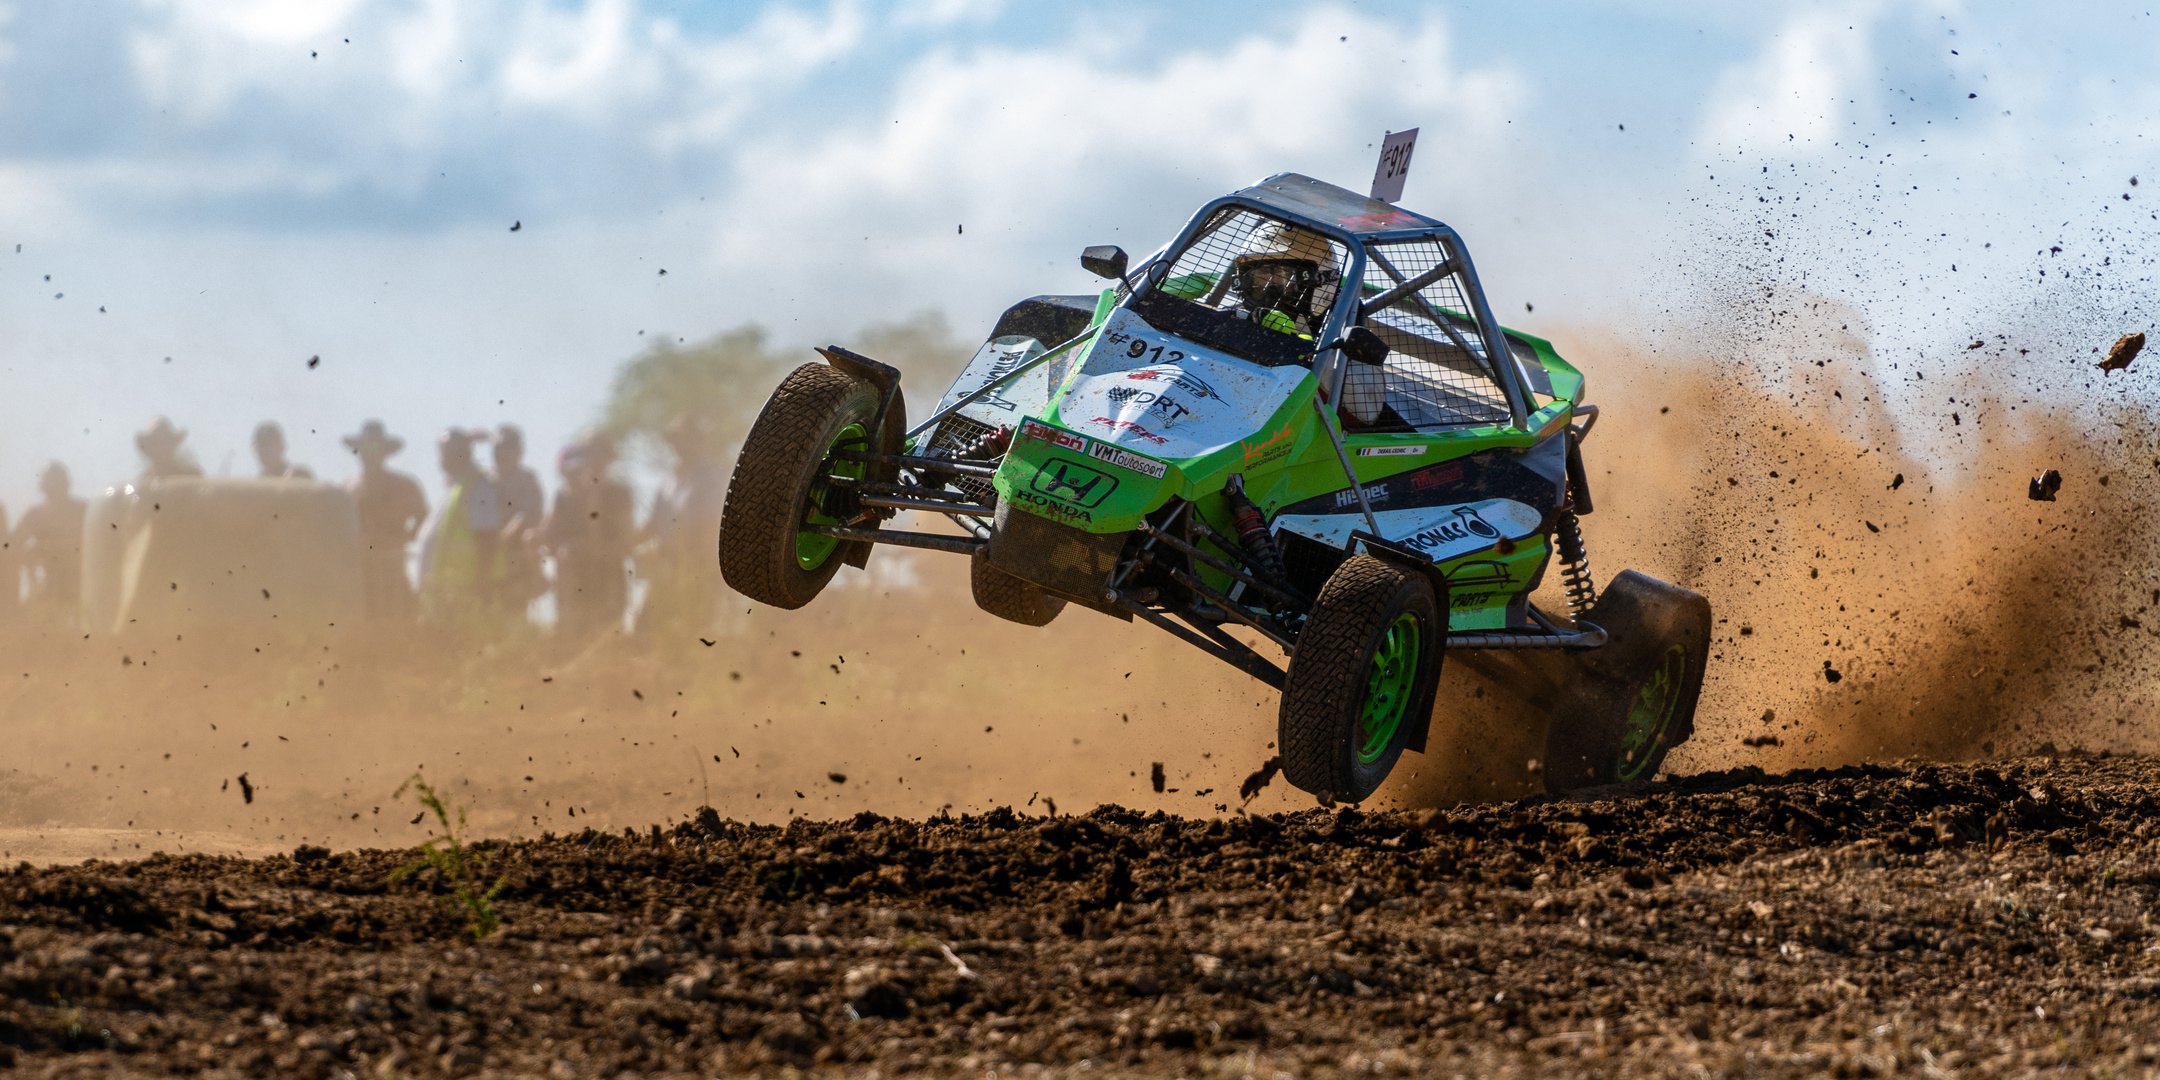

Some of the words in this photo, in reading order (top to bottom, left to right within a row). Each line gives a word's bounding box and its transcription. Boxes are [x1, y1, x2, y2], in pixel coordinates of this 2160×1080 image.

[1381, 141, 1412, 178] #912
[1108, 332, 1184, 365] #912
[1134, 391, 1189, 419] DRT
[1094, 444, 1164, 478] VMTautosport
[1016, 489, 1092, 523] HONDA
